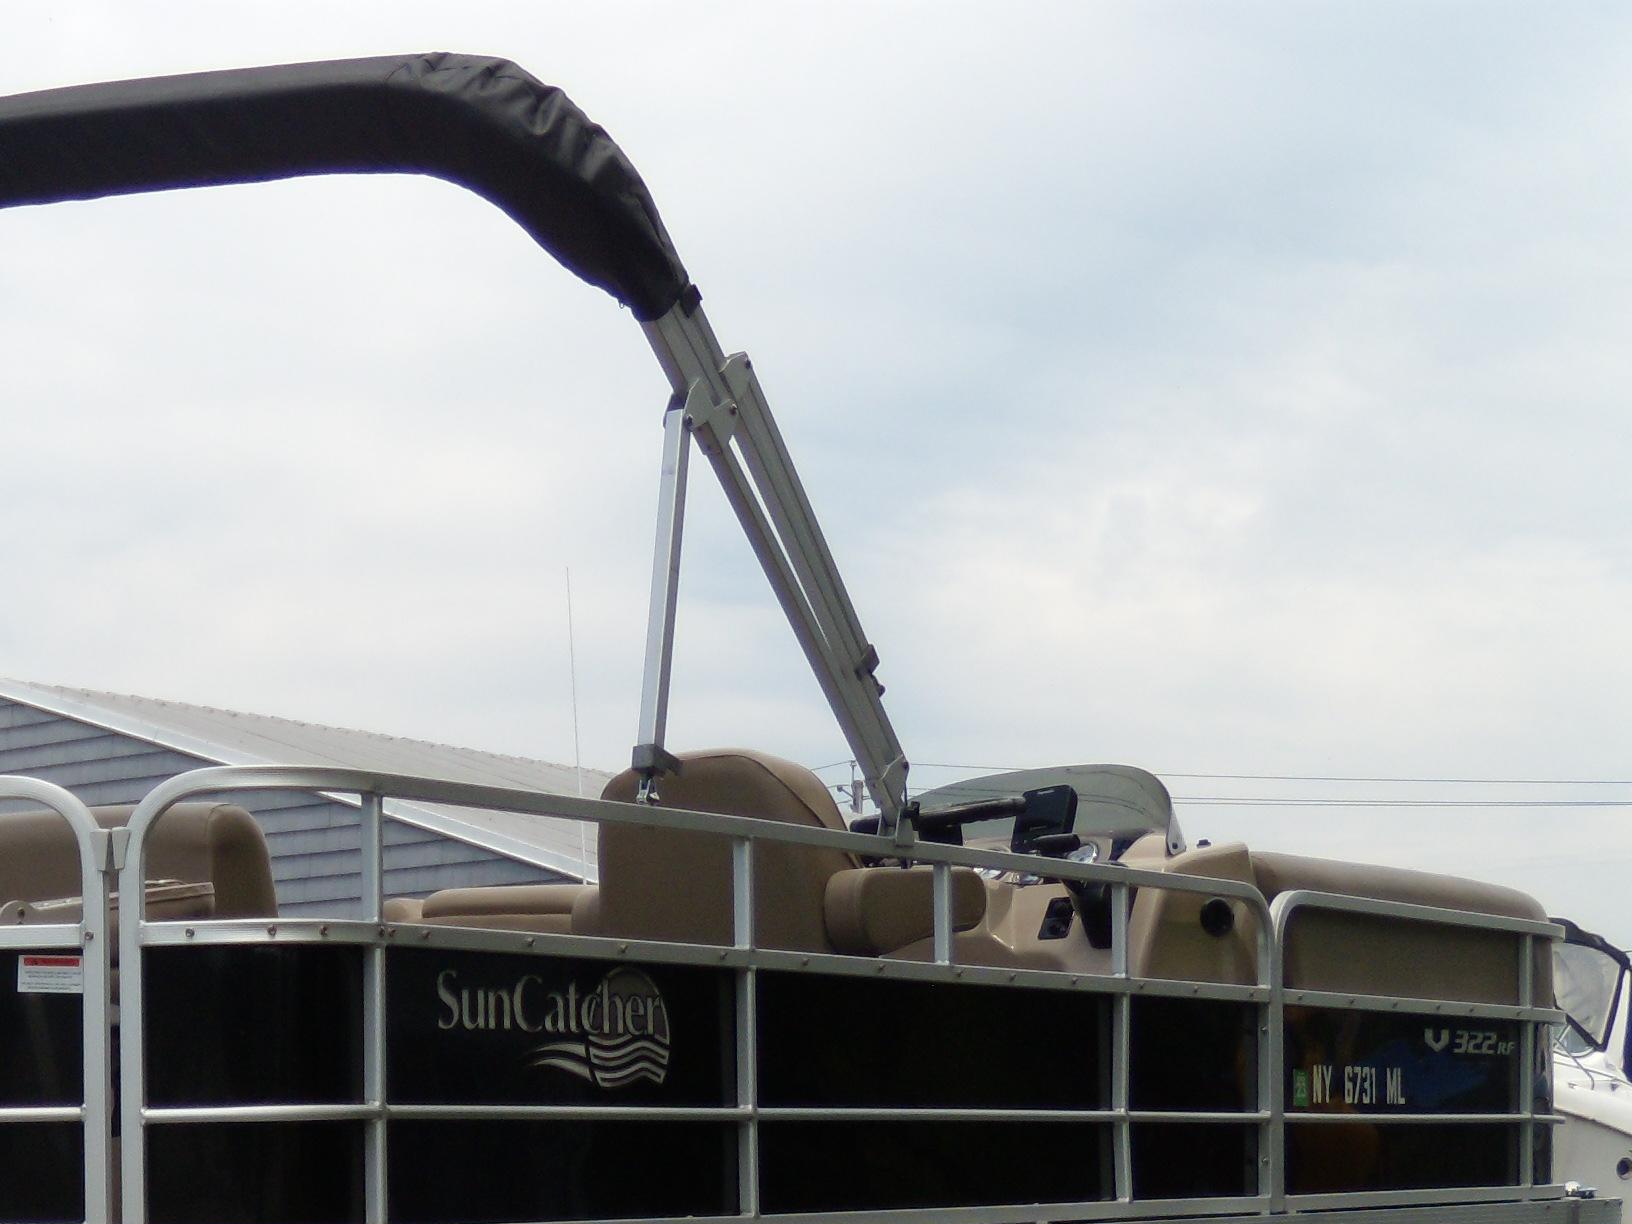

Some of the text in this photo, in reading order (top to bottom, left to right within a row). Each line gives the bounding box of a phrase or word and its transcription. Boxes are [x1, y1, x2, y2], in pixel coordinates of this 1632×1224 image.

[436, 968, 664, 1036] SunCatcher
[1312, 1064, 1333, 1105] NY
[1344, 1065, 1376, 1105] 6731
[1386, 1066, 1406, 1105] ML
